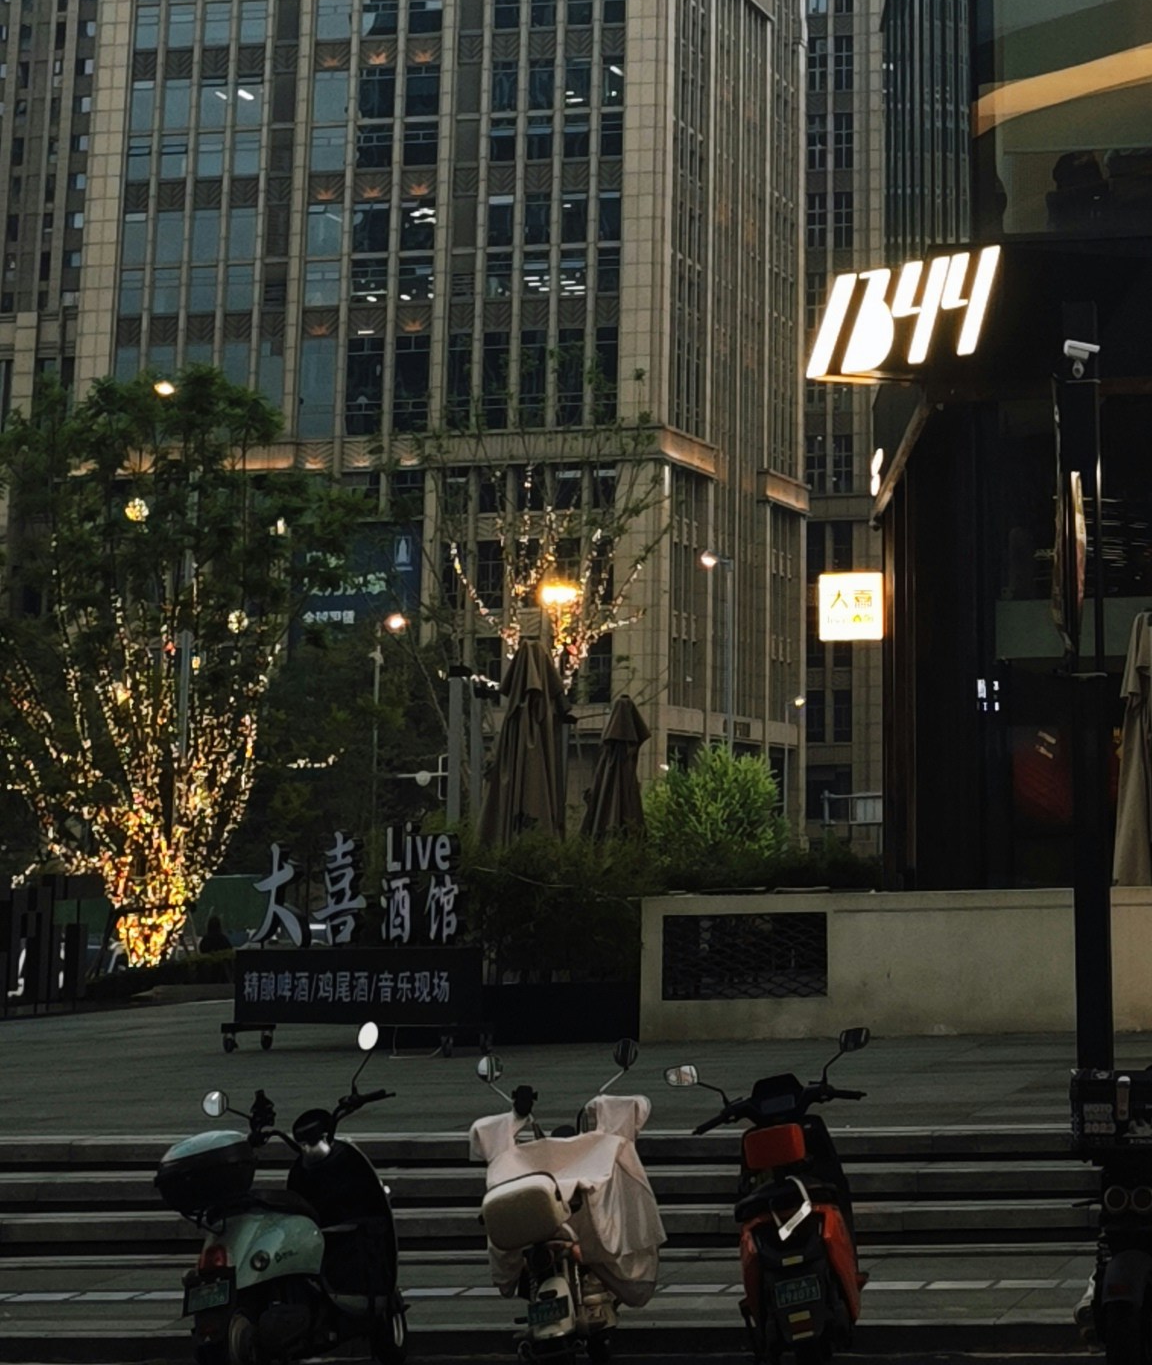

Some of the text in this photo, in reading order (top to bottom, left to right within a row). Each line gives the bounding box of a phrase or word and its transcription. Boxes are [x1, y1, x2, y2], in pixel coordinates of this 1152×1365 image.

[386, 822, 452, 873] Live
[251, 830, 367, 948] 大喜
[381, 874, 459, 944] 酒馆
